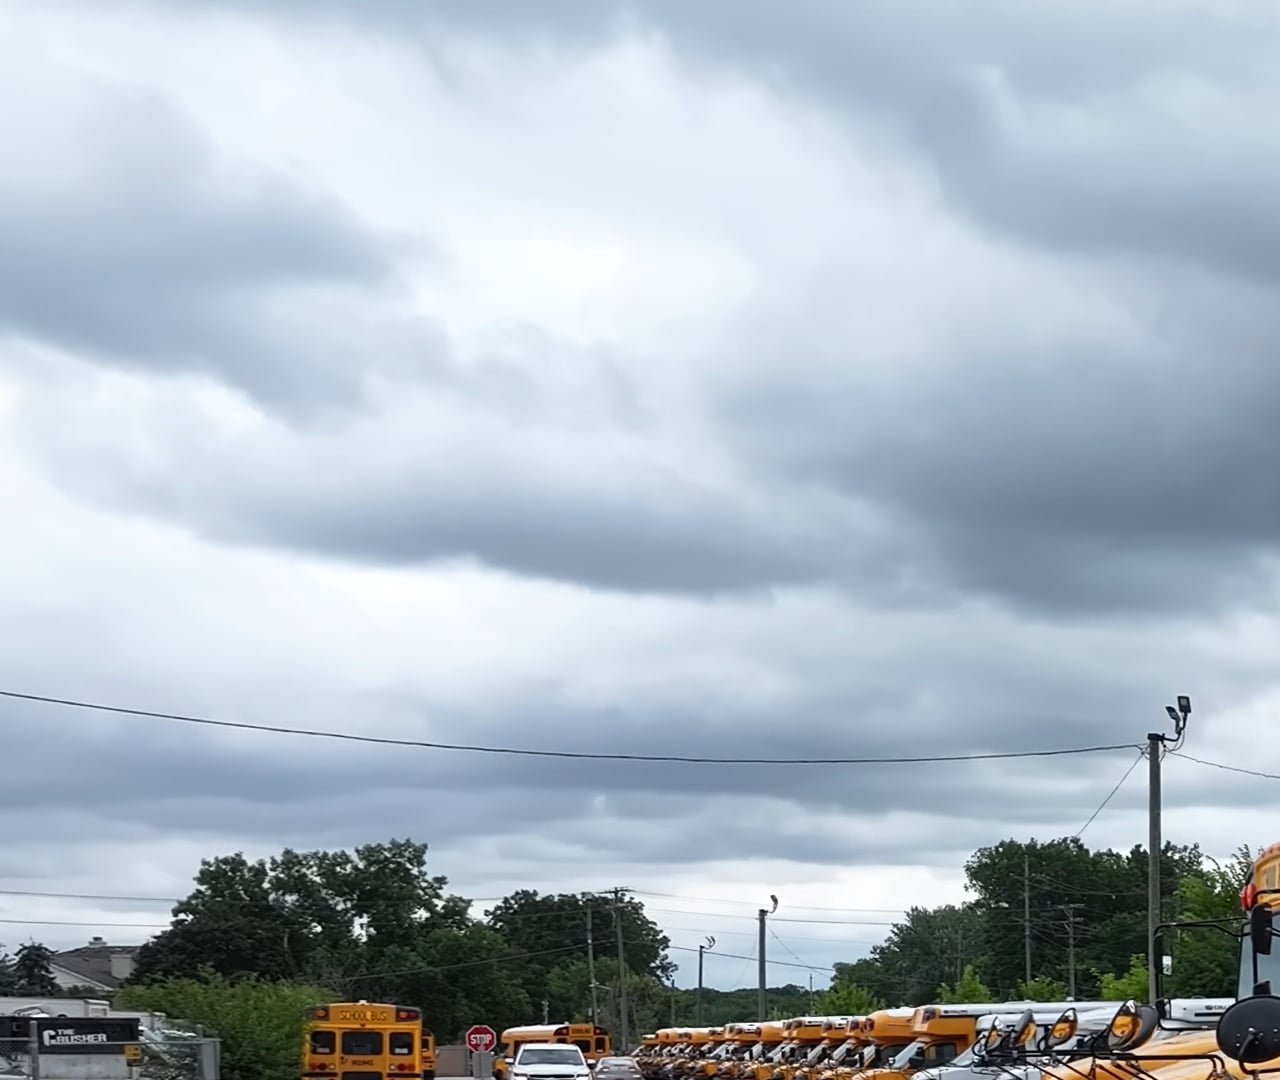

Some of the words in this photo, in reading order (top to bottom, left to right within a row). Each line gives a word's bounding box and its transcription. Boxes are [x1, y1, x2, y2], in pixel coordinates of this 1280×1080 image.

[340, 1010, 369, 1021] SCHOOL
[371, 1010, 387, 1021] BUS
[469, 1034, 493, 1045] STOP
